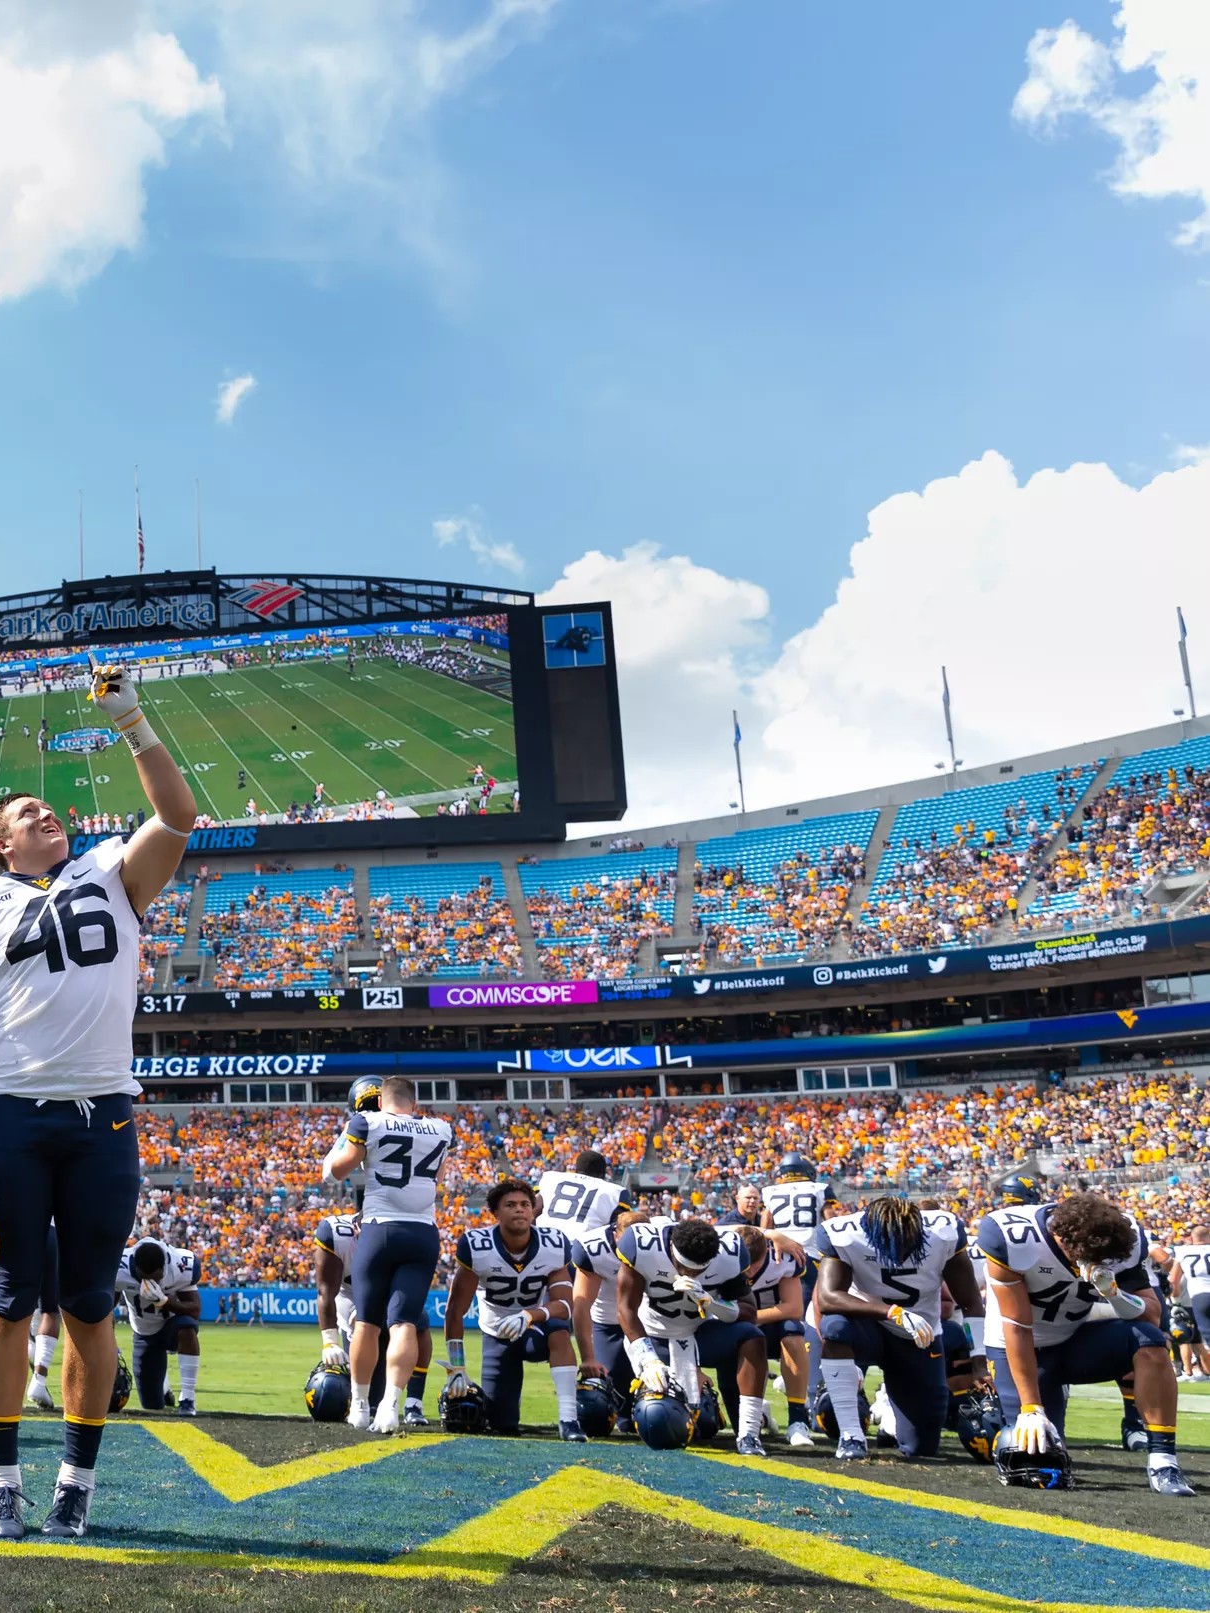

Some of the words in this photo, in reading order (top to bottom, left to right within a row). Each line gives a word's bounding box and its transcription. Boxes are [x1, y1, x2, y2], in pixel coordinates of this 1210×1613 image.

[55, 603, 84, 633] of
[89, 598, 215, 631] America
[74, 775, 111, 788] 50
[187, 827, 258, 850] NTHERS
[5, 882, 119, 974] 46
[988, 955, 1003, 963] We
[1004, 953, 1019, 961] are
[1020, 950, 1043, 960] ready
[1116, 937, 1129, 946] Go
[714, 976, 785, 991] #BelkKickoff
[836, 964, 908, 981] #BelkKickoff
[142, 994, 186, 1012] 3:17
[225, 992, 240, 1000] QTR
[230, 1000, 236, 1008] 1
[250, 991, 272, 999] DOWN
[284, 990, 291, 998] TO
[292, 990, 305, 998] GO
[314, 989, 332, 997] BALL
[334, 989, 345, 997] ON
[319, 996, 339, 1010] 35
[369, 989, 398, 1007] 25
[134, 1057, 200, 1077] LEGE
[207, 1055, 326, 1076] KICKOFF
[386, 1119, 439, 1136] CAMPBELL
[375, 1134, 449, 1189] 34
[547, 1181, 599, 1223] 81
[770, 1193, 818, 1229] 28
[635, 1225, 663, 1252] 25
[1002, 1213, 1041, 1244] 45
[467, 1229, 494, 1252] 29
[584, 1237, 610, 1257] 15
[486, 1275, 549, 1308] 29
[881, 1267, 920, 1308] 5
[436, 1297, 480, 1319] blk
